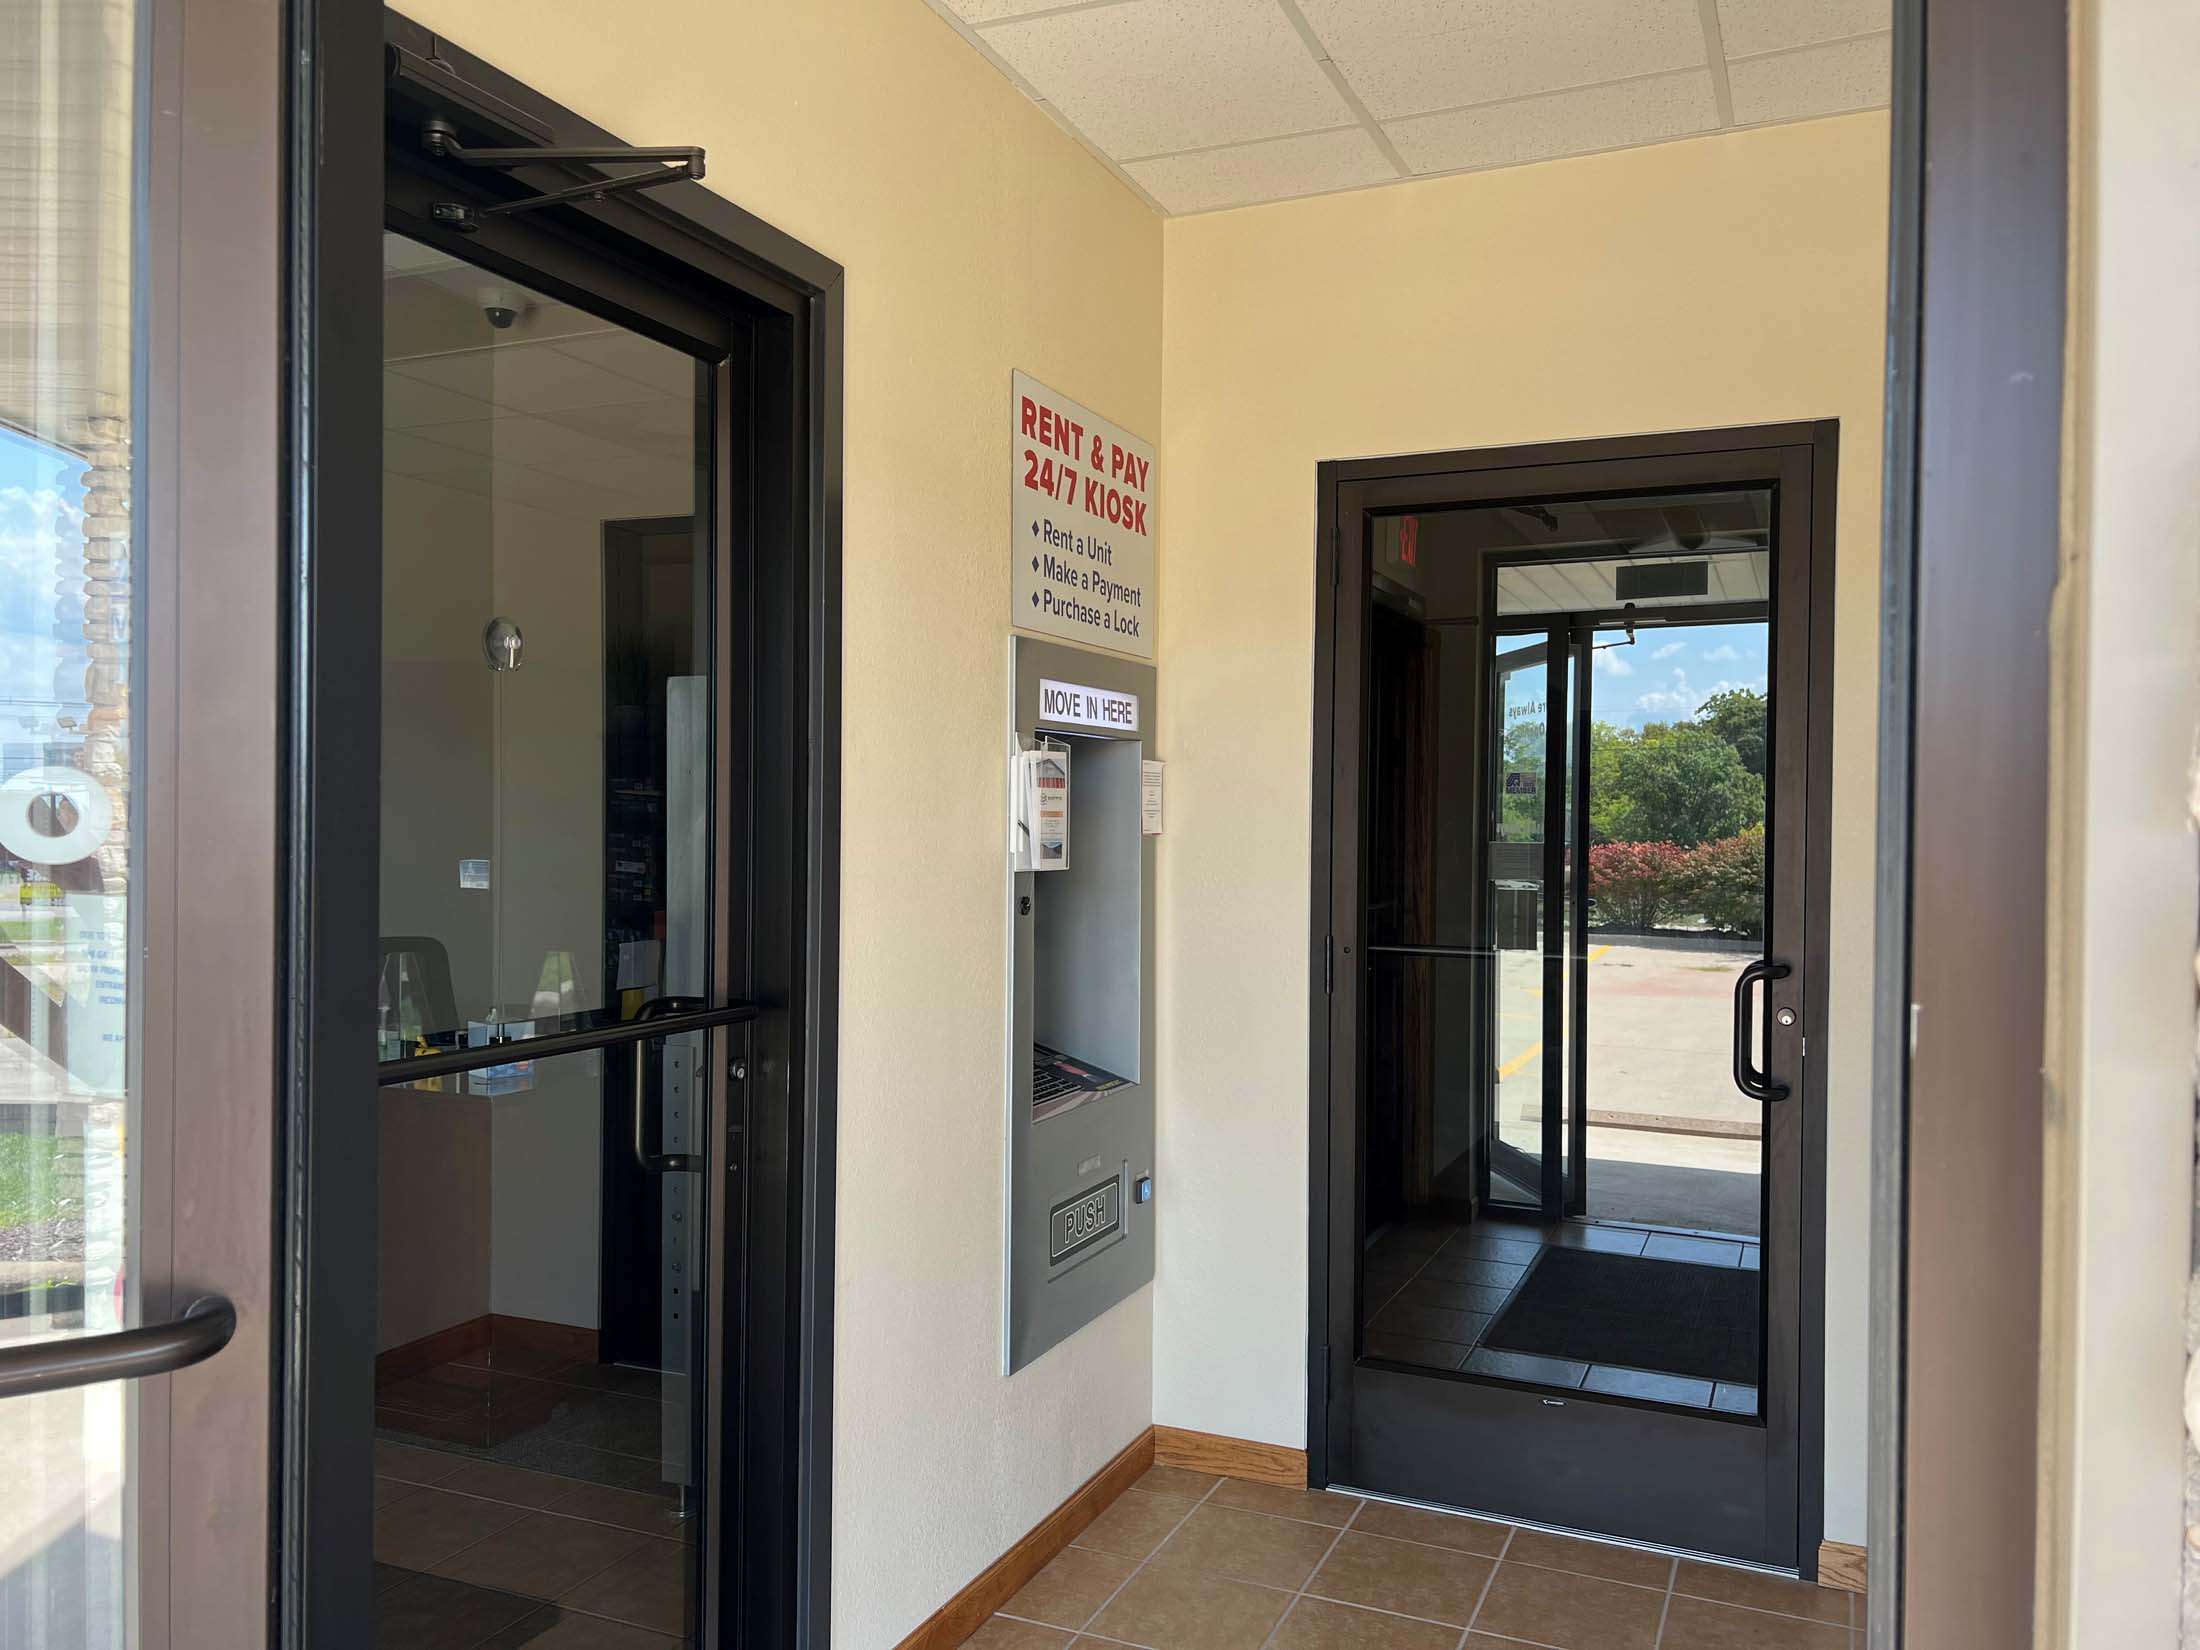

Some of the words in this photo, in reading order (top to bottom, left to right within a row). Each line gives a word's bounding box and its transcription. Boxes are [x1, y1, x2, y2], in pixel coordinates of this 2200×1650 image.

[1021, 395, 1083, 461] RENT
[1091, 435, 1104, 473] &
[1112, 443, 1149, 492] PAY
[1024, 449, 1077, 505] 24/7
[1085, 476, 1147, 536] KIOSK
[1043, 519, 1073, 552] Rent
[1076, 538, 1084, 555] a
[1087, 536, 1112, 566] Unit
[1043, 554, 1078, 587] Make
[1081, 572, 1088, 590] a
[1092, 570, 1141, 607] Payment
[1043, 588, 1101, 626] Purchase
[1104, 612, 1111, 629] a
[1114, 609, 1140, 637] Lock
[1044, 688, 1080, 717] MOVE
[1086, 695, 1098, 720] IN
[1102, 700, 1132, 724] HERE
[1064, 1194, 1105, 1244] PUSH
